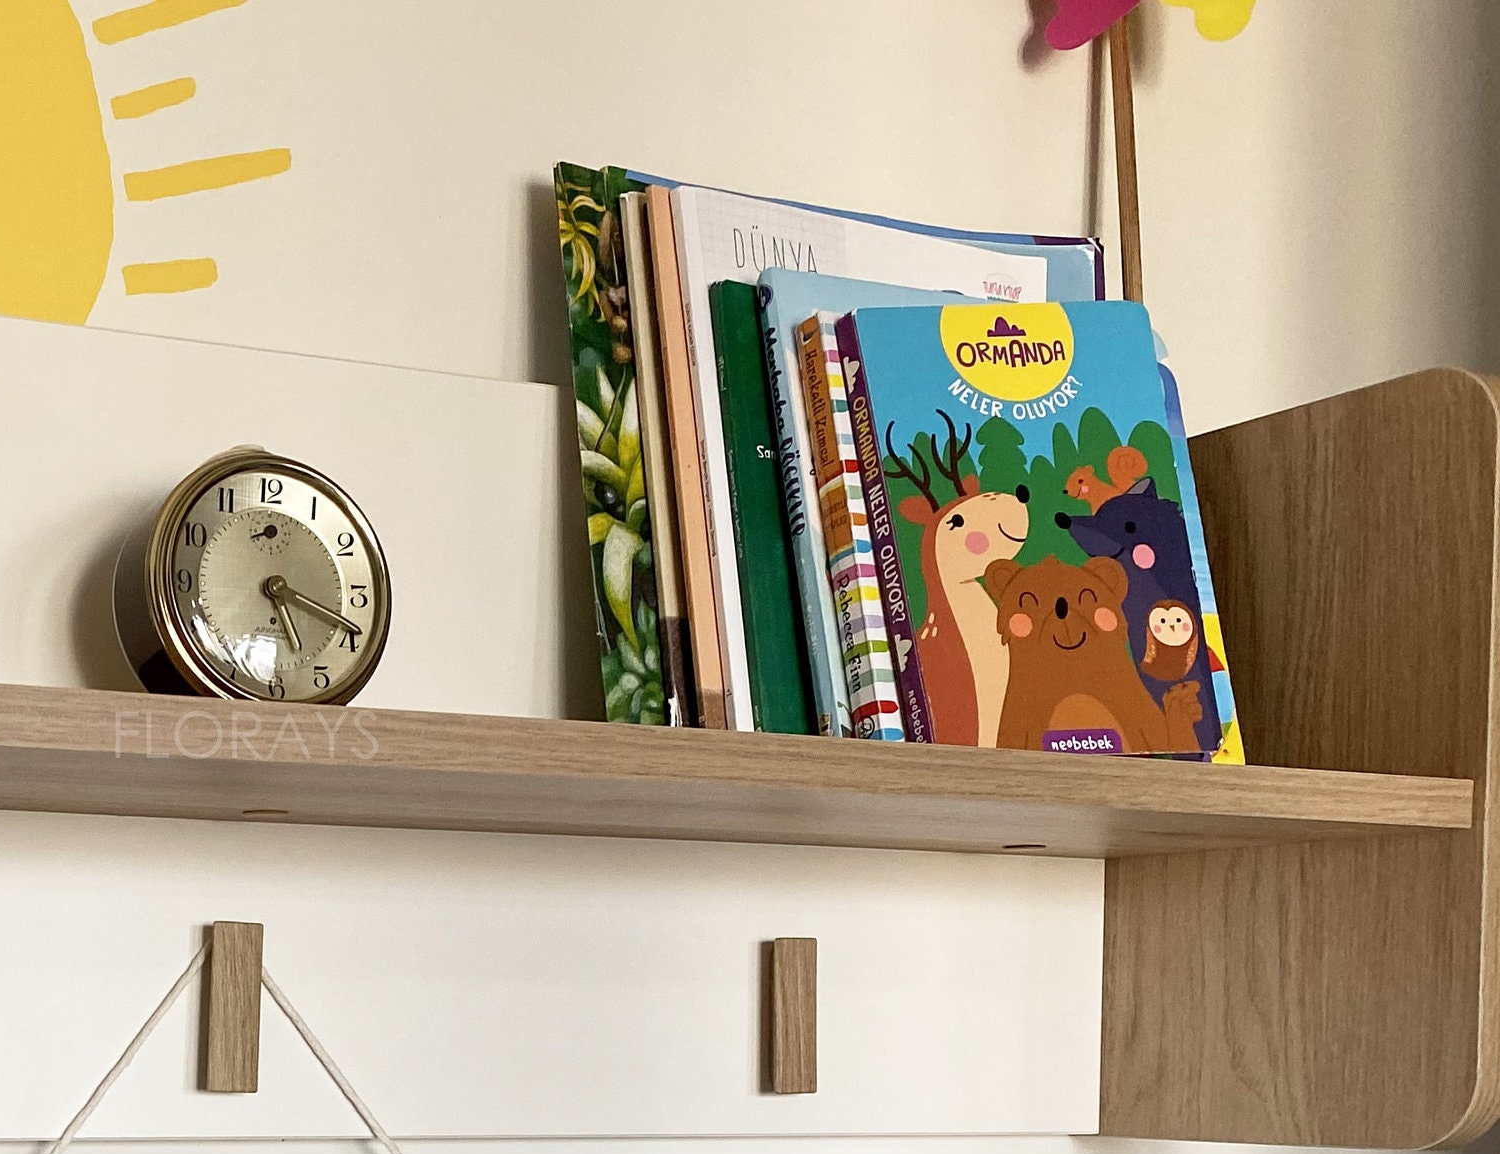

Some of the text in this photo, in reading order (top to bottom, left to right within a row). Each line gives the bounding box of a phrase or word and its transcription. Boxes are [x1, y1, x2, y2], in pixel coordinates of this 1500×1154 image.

[733, 226, 818, 274] DÜNYA
[956, 339, 1066, 368] ORMANDA
[765, 327, 787, 434] Merhaba
[805, 350, 834, 468] Hareketli Kumsal
[948, 375, 1083, 420] NELER OLUYOR?
[217, 487, 234, 513] 11
[260, 478, 282, 504] 12
[311, 496, 317, 520] 1
[853, 396, 906, 624] ORMANDA NELER OLUYOR?
[184, 522, 207, 549] 10
[337, 532, 354, 557] 2
[177, 569, 192, 593] 9
[350, 585, 368, 609] 3
[838, 575, 861, 693] Rebecca Finn
[314, 666, 330, 690] 5
[908, 689, 926, 744] neobebe
[1051, 735, 1114, 750] neobebek
